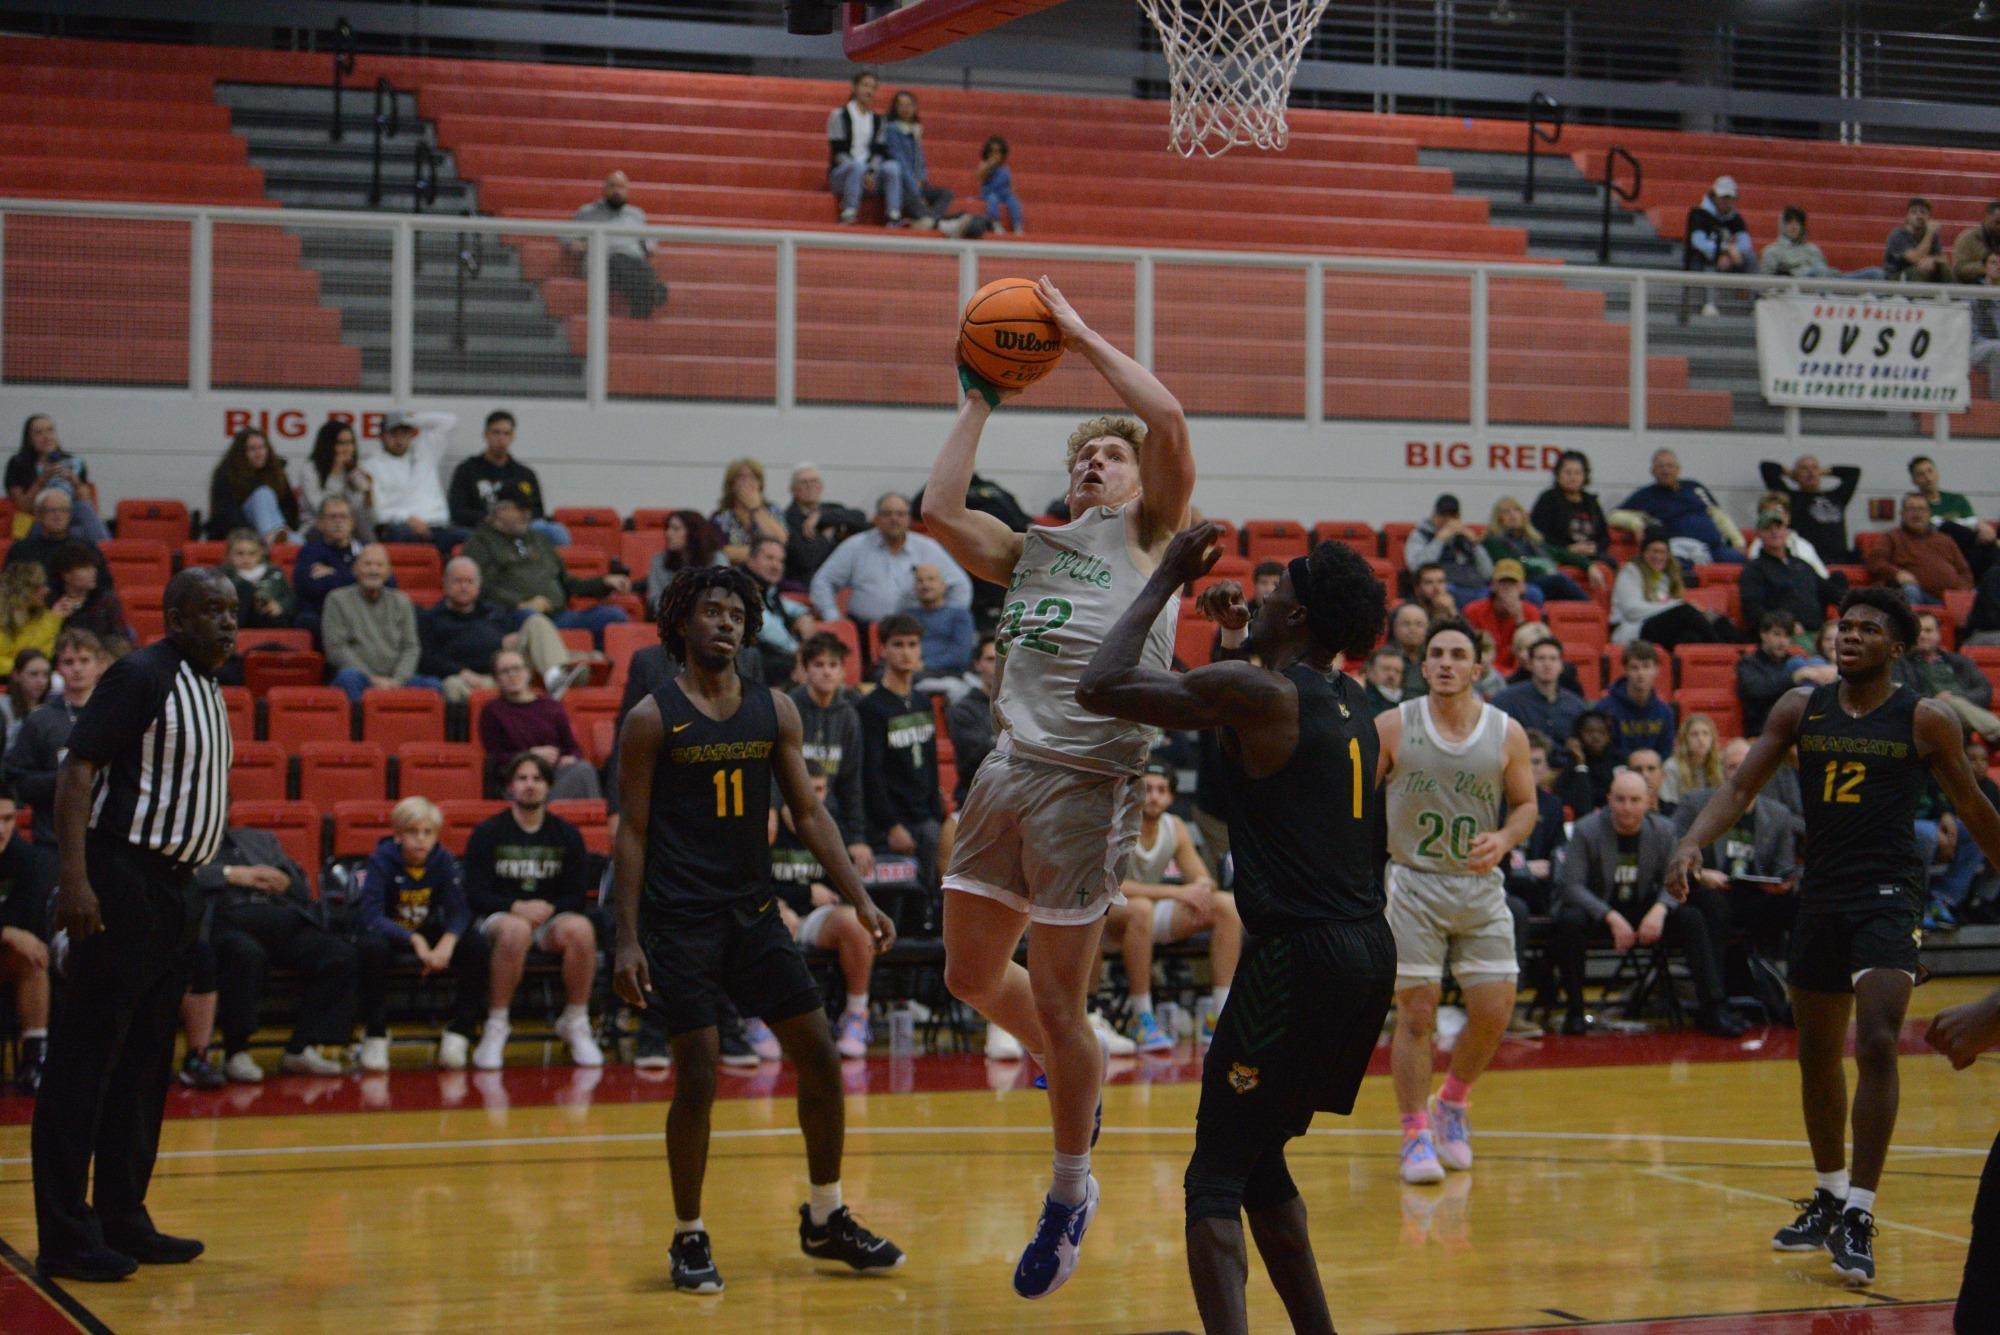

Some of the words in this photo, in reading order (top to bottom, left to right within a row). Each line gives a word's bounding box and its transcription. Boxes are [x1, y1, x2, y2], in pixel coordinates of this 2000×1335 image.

[995, 329, 1060, 352] Wilson
[1800, 362, 1864, 376] SPORTS
[1869, 364, 1930, 381] ONLINE
[1803, 381, 1865, 397] SPORTS
[1869, 385, 1957, 401] AUTHORITY
[1406, 442, 1473, 468] BIG
[1488, 445, 1564, 471] RED
[1049, 549, 1112, 590] Ville
[1800, 734, 1908, 759] BEARCATS
[1348, 737, 1363, 819] 1
[1404, 770, 1437, 794] The
[1823, 760, 1867, 803] 12
[712, 768, 745, 818] 11
[1416, 811, 1478, 860] 20
